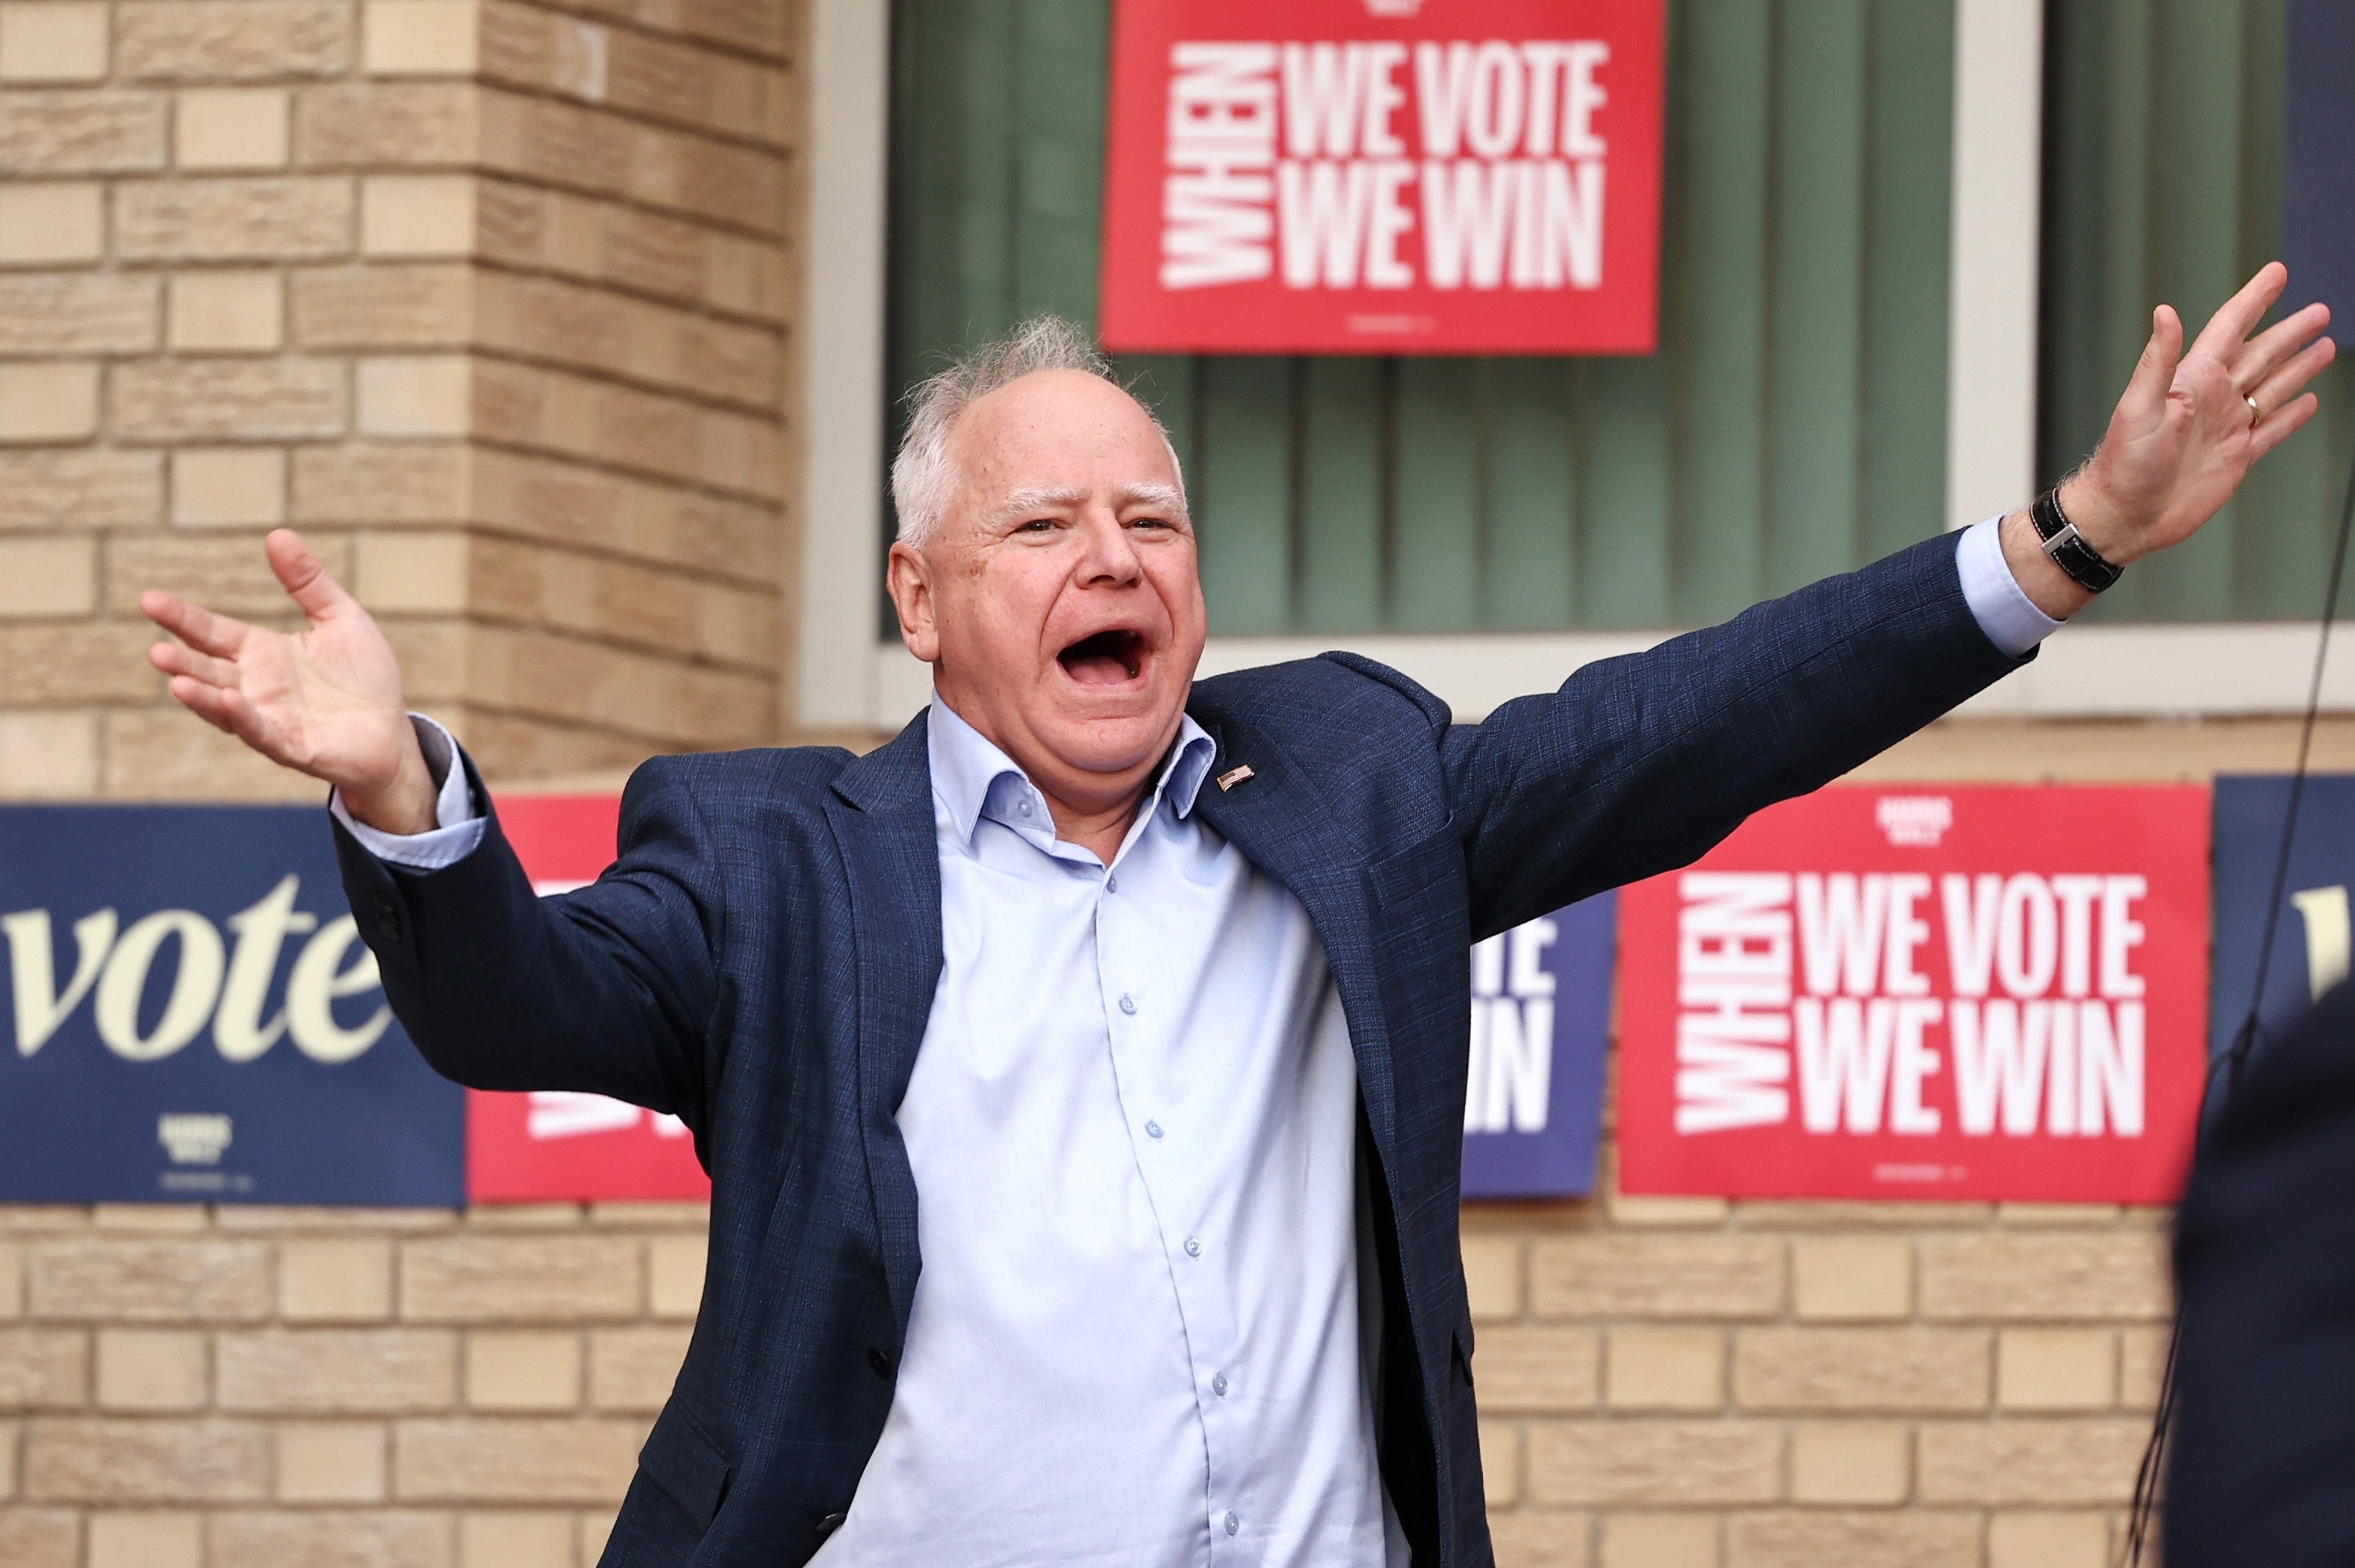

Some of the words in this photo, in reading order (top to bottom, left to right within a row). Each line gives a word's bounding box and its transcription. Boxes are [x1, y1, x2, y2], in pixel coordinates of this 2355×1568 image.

[1277, 43, 1406, 155] WE
[1416, 42, 1608, 155] VOTE
[1160, 43, 1275, 288] WHEN
[1277, 160, 1415, 287] WE
[1421, 161, 1603, 287] WIN
[3, 873, 394, 1063] vote
[1795, 872, 1931, 996] WE
[1942, 873, 2147, 996] VOTE
[1463, 1001, 1553, 1133] IN
[1675, 871, 1791, 1133] WHEN
[1794, 1001, 1943, 1133] WE
[1950, 1001, 2145, 1136] WIN
